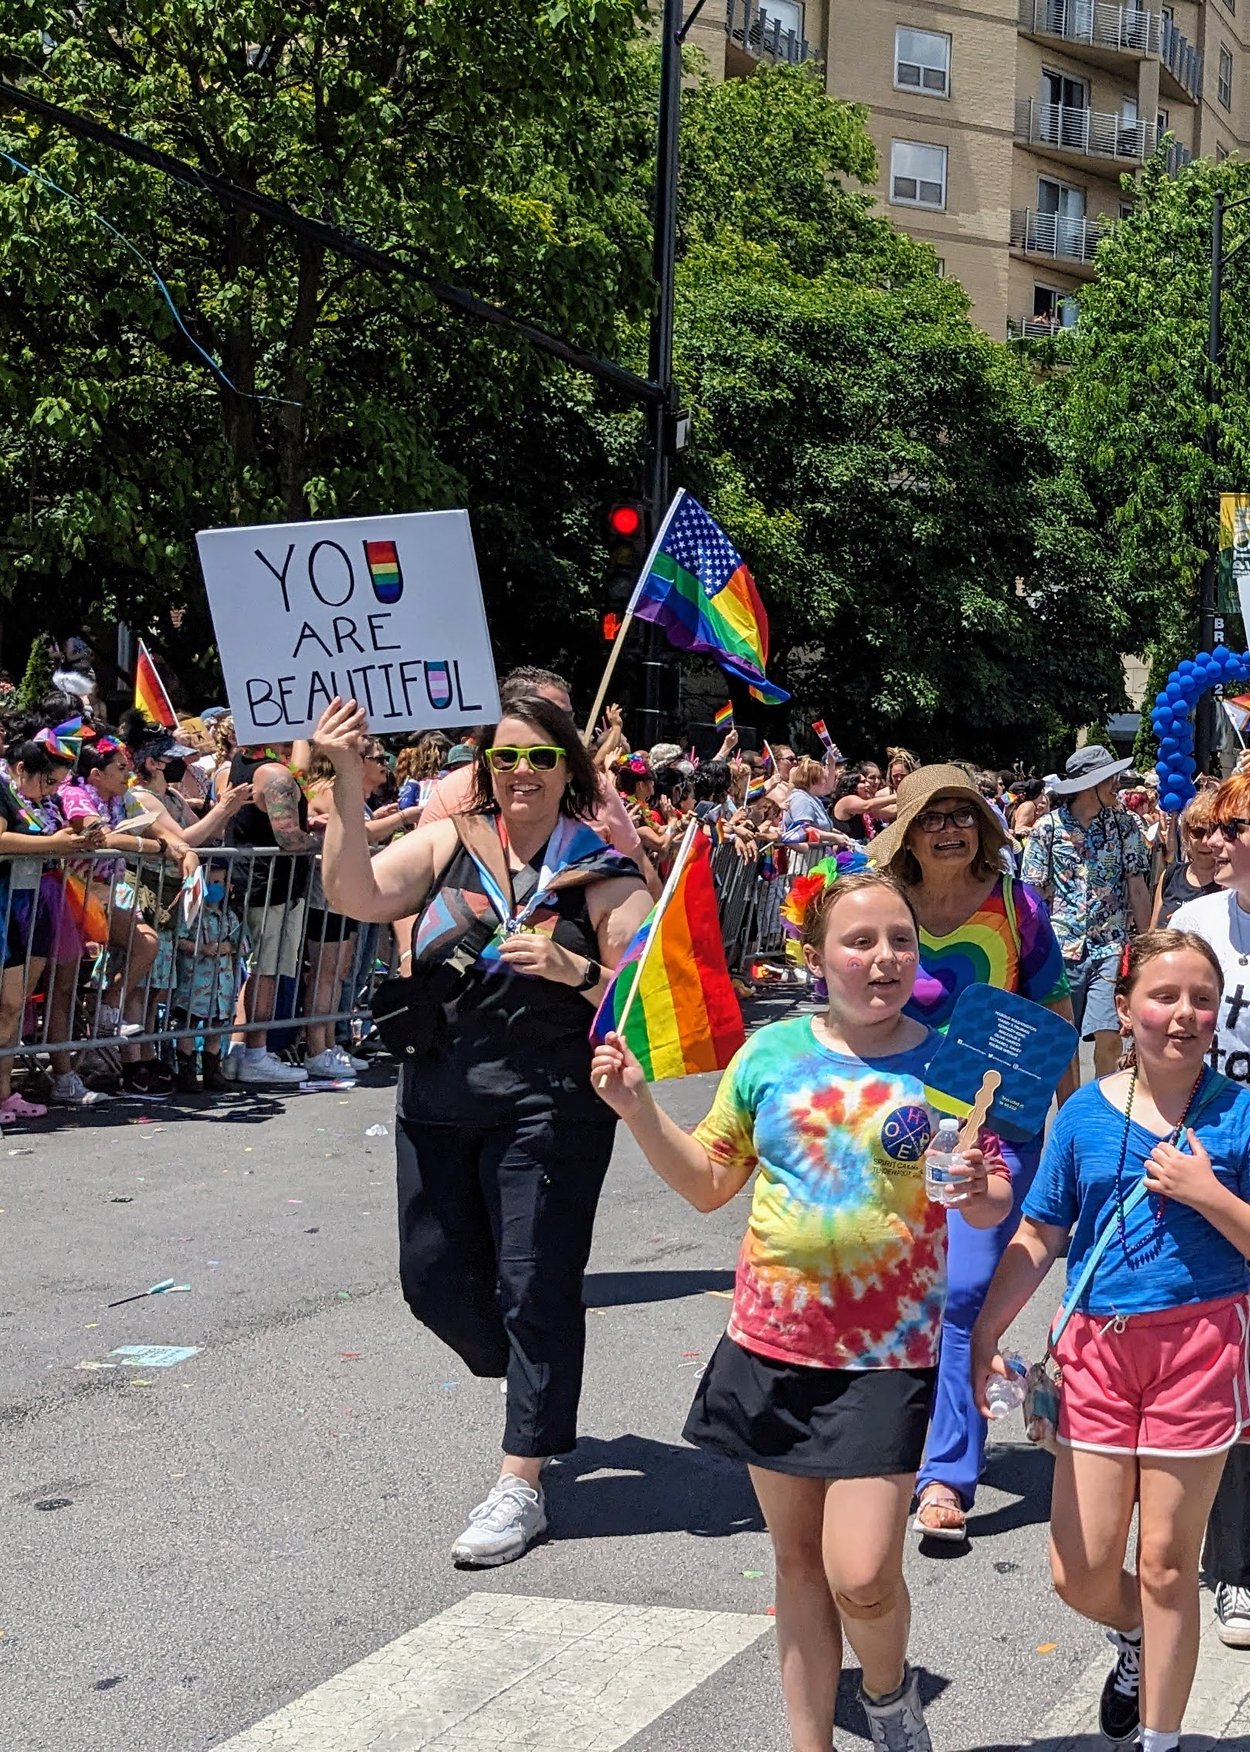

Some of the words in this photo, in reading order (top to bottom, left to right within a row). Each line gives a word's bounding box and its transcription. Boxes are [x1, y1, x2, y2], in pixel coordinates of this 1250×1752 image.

[254, 539, 404, 612] YOU
[293, 612, 402, 658] ARE
[246, 659, 483, 727] BEAUTIFUL
[873, 1158, 896, 1169] SPIRIT
